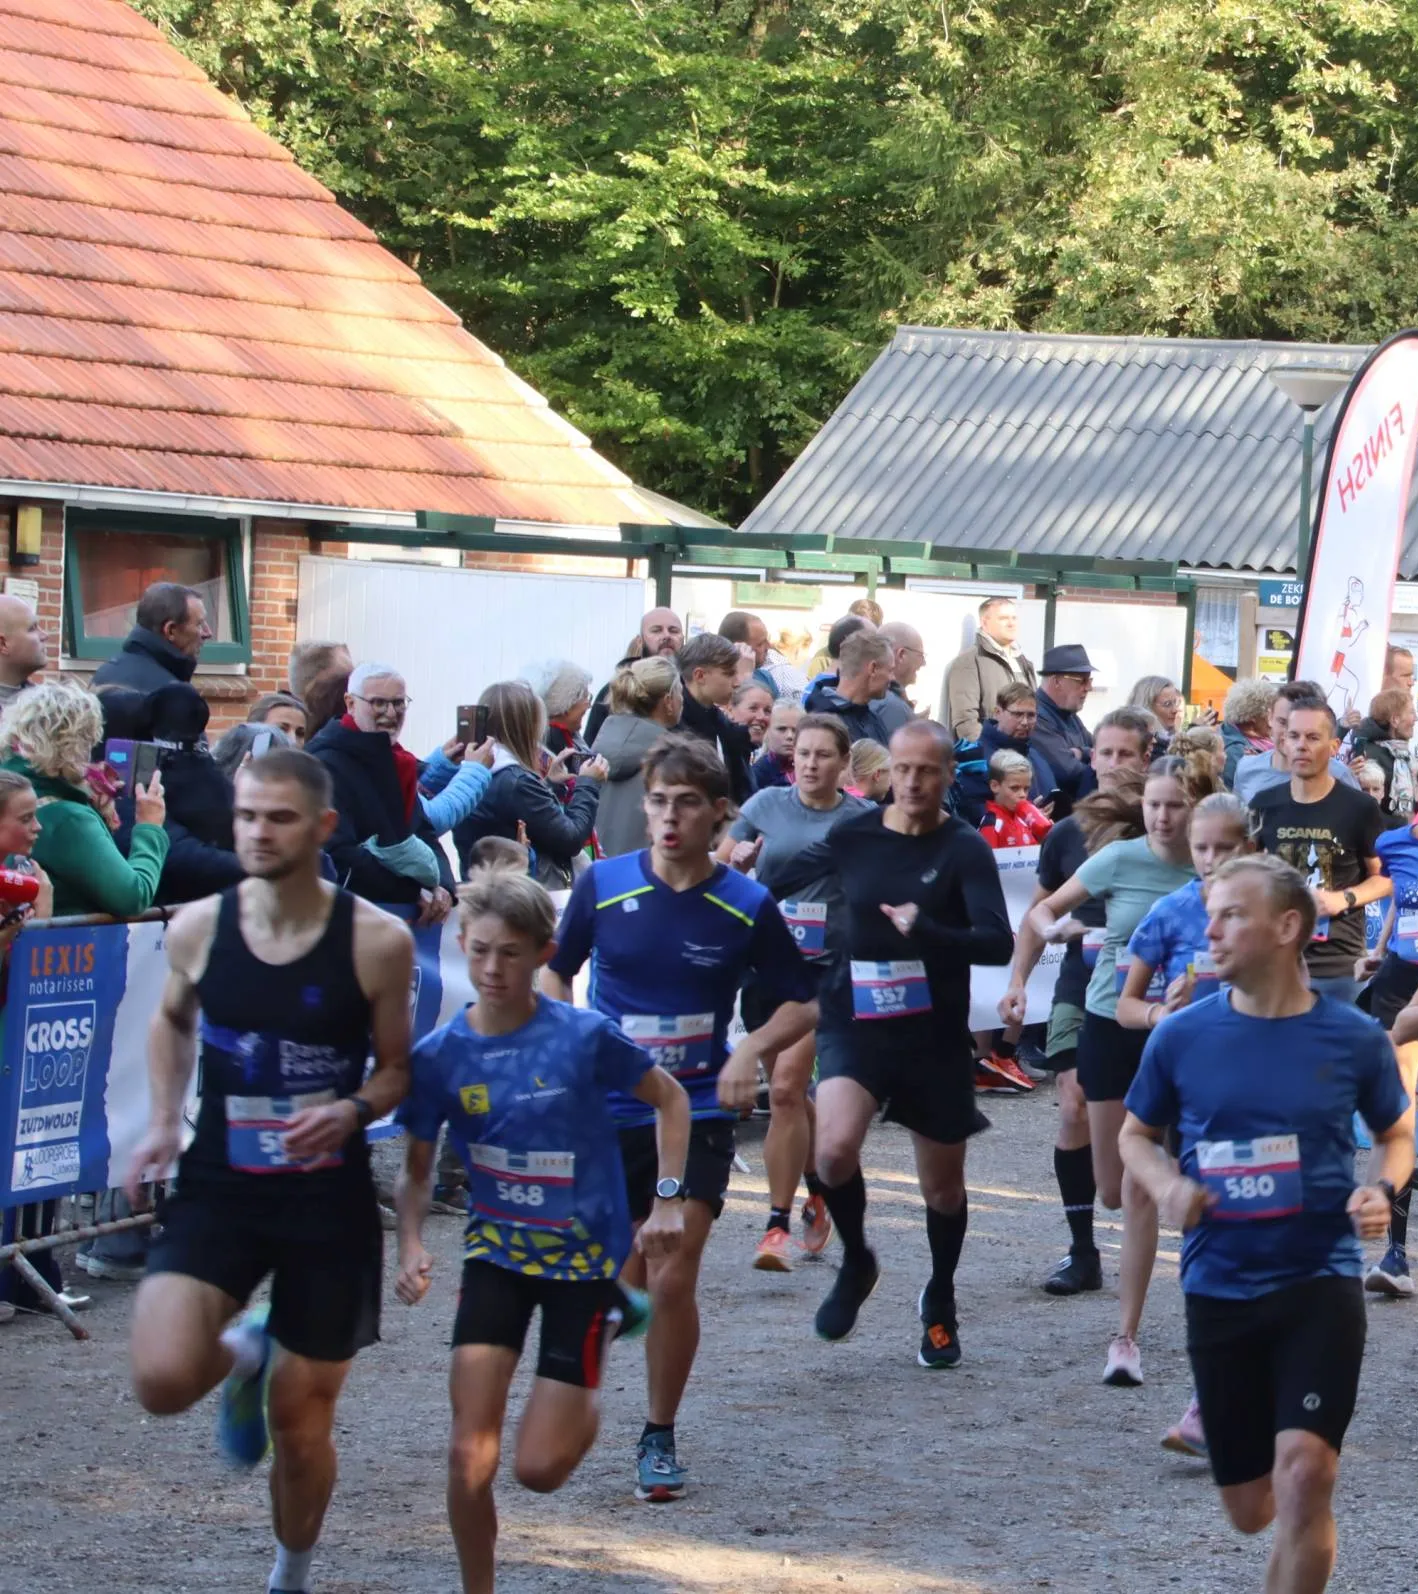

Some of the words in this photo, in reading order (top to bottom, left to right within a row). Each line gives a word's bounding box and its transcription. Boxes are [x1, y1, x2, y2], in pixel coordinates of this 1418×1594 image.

[1270, 594, 1282, 604] DE
[1277, 827, 1333, 840] SCANIA
[30, 943, 95, 977] LEXIS
[29, 977, 94, 996] notarissen
[871, 985, 907, 1005] 557
[26, 1017, 92, 1053] CROSS
[24, 1051, 85, 1093] LOOP
[19, 1110, 79, 1135] ZUIDWOLDE
[496, 1180, 544, 1206] 568
[1224, 1174, 1275, 1199] 580
